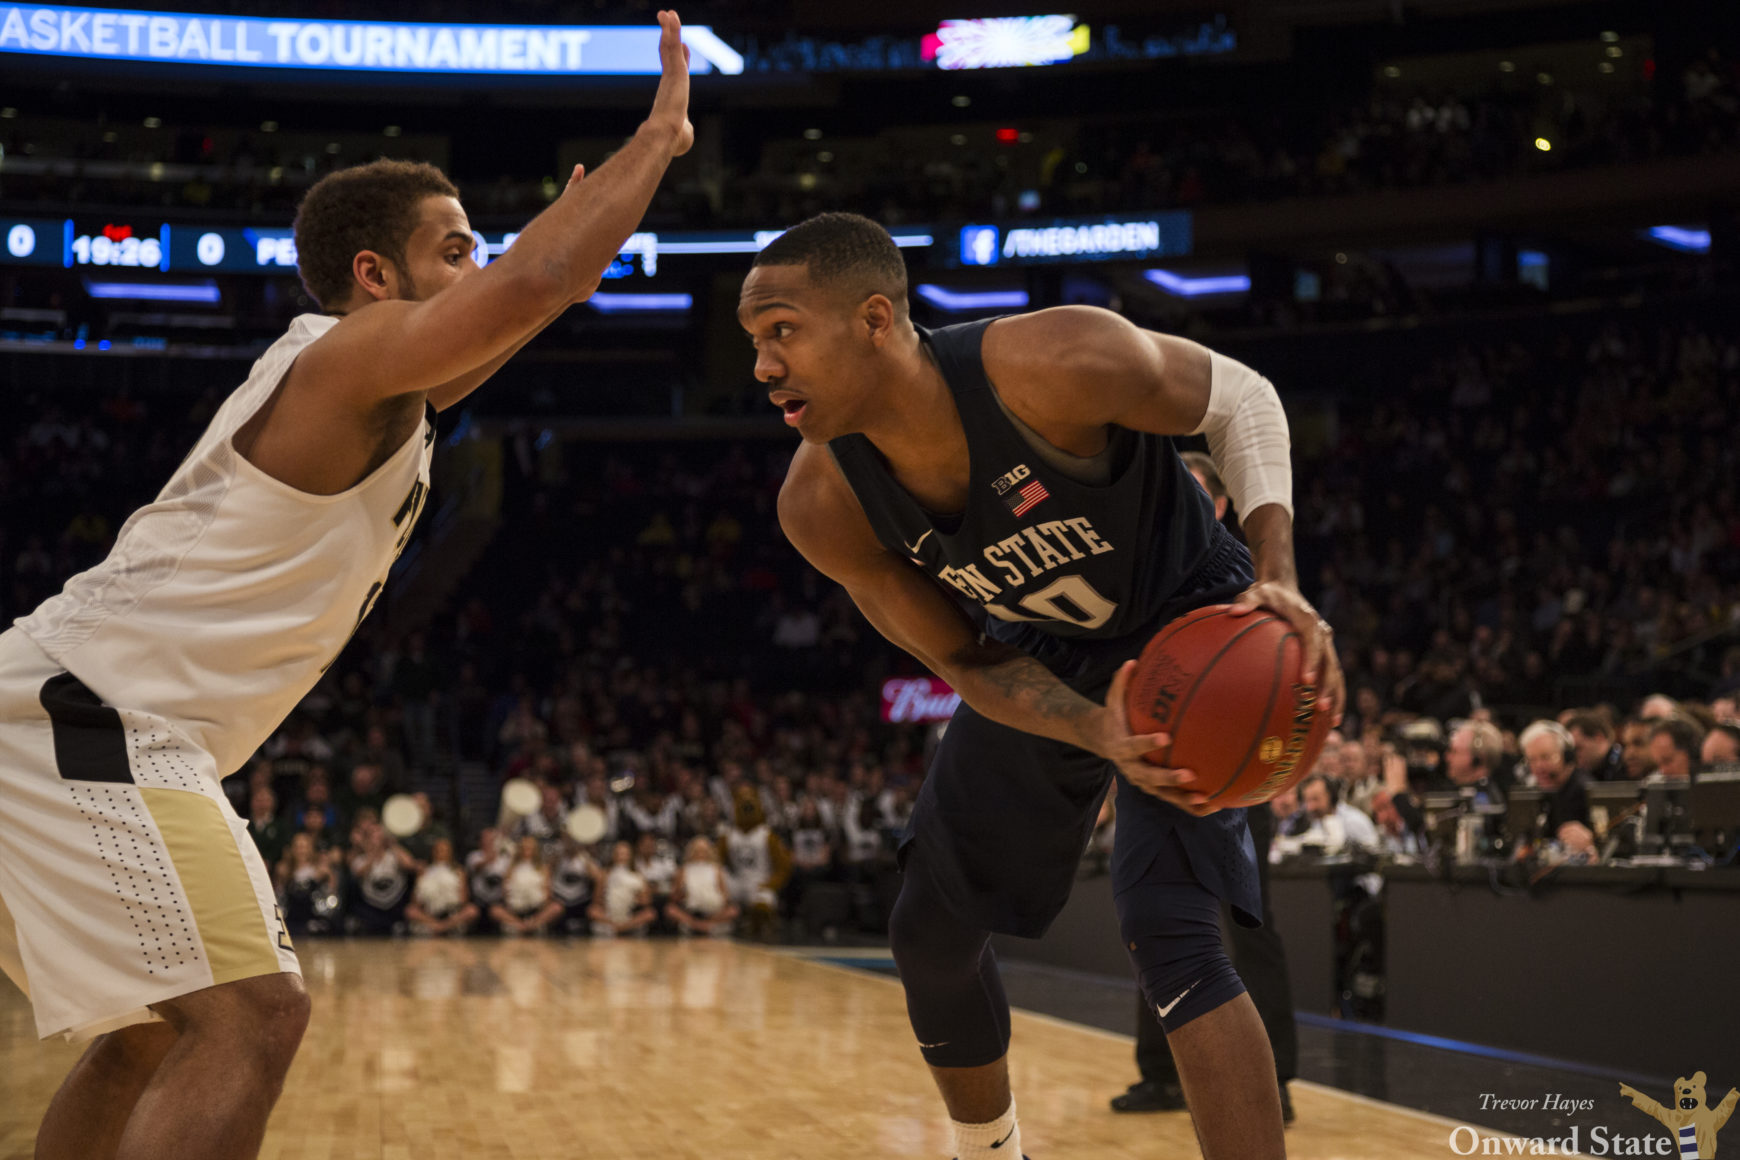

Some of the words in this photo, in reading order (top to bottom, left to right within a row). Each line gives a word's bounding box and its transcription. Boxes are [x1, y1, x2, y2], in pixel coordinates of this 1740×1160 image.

[267, 22, 592, 70] TOURNAMENT
[7, 223, 36, 258] 0
[72, 234, 162, 268] 19:26
[197, 232, 225, 266] 0
[983, 516, 1115, 588] STATE
